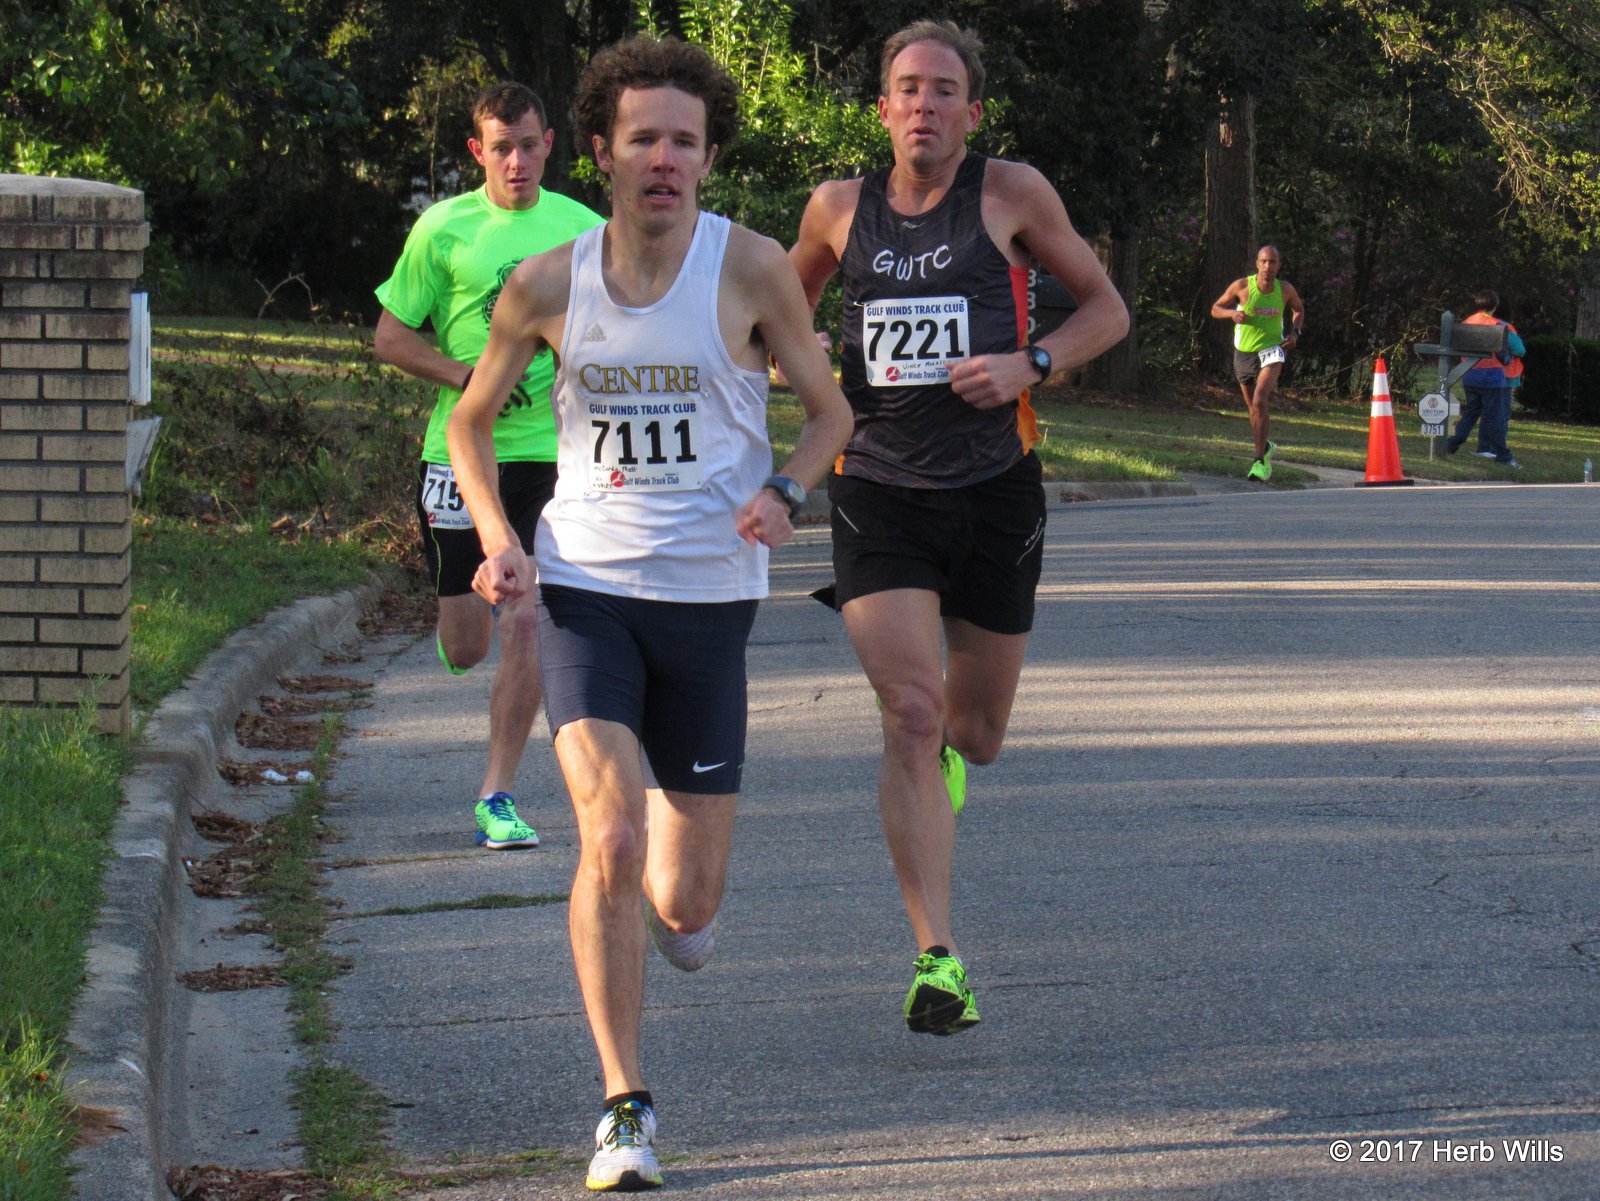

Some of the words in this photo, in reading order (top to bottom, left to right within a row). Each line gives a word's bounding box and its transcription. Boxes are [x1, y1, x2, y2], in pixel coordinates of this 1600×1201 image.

[873, 245, 952, 281] GWTC
[867, 306, 883, 316] GULF
[886, 305, 912, 315] WINDS
[915, 304, 941, 314] TRACK
[944, 303, 965, 313] CLUB
[867, 318, 965, 361] 7221
[579, 363, 701, 394] CENTRE
[589, 404, 607, 415] GULF
[609, 404, 638, 415] WINDS
[641, 404, 671, 415] TRACK
[673, 402, 697, 413] CLUB
[591, 419, 697, 465] 7111
[634, 477, 650, 486] Winds
[652, 476, 666, 485] Track
[667, 476, 680, 485] Club
